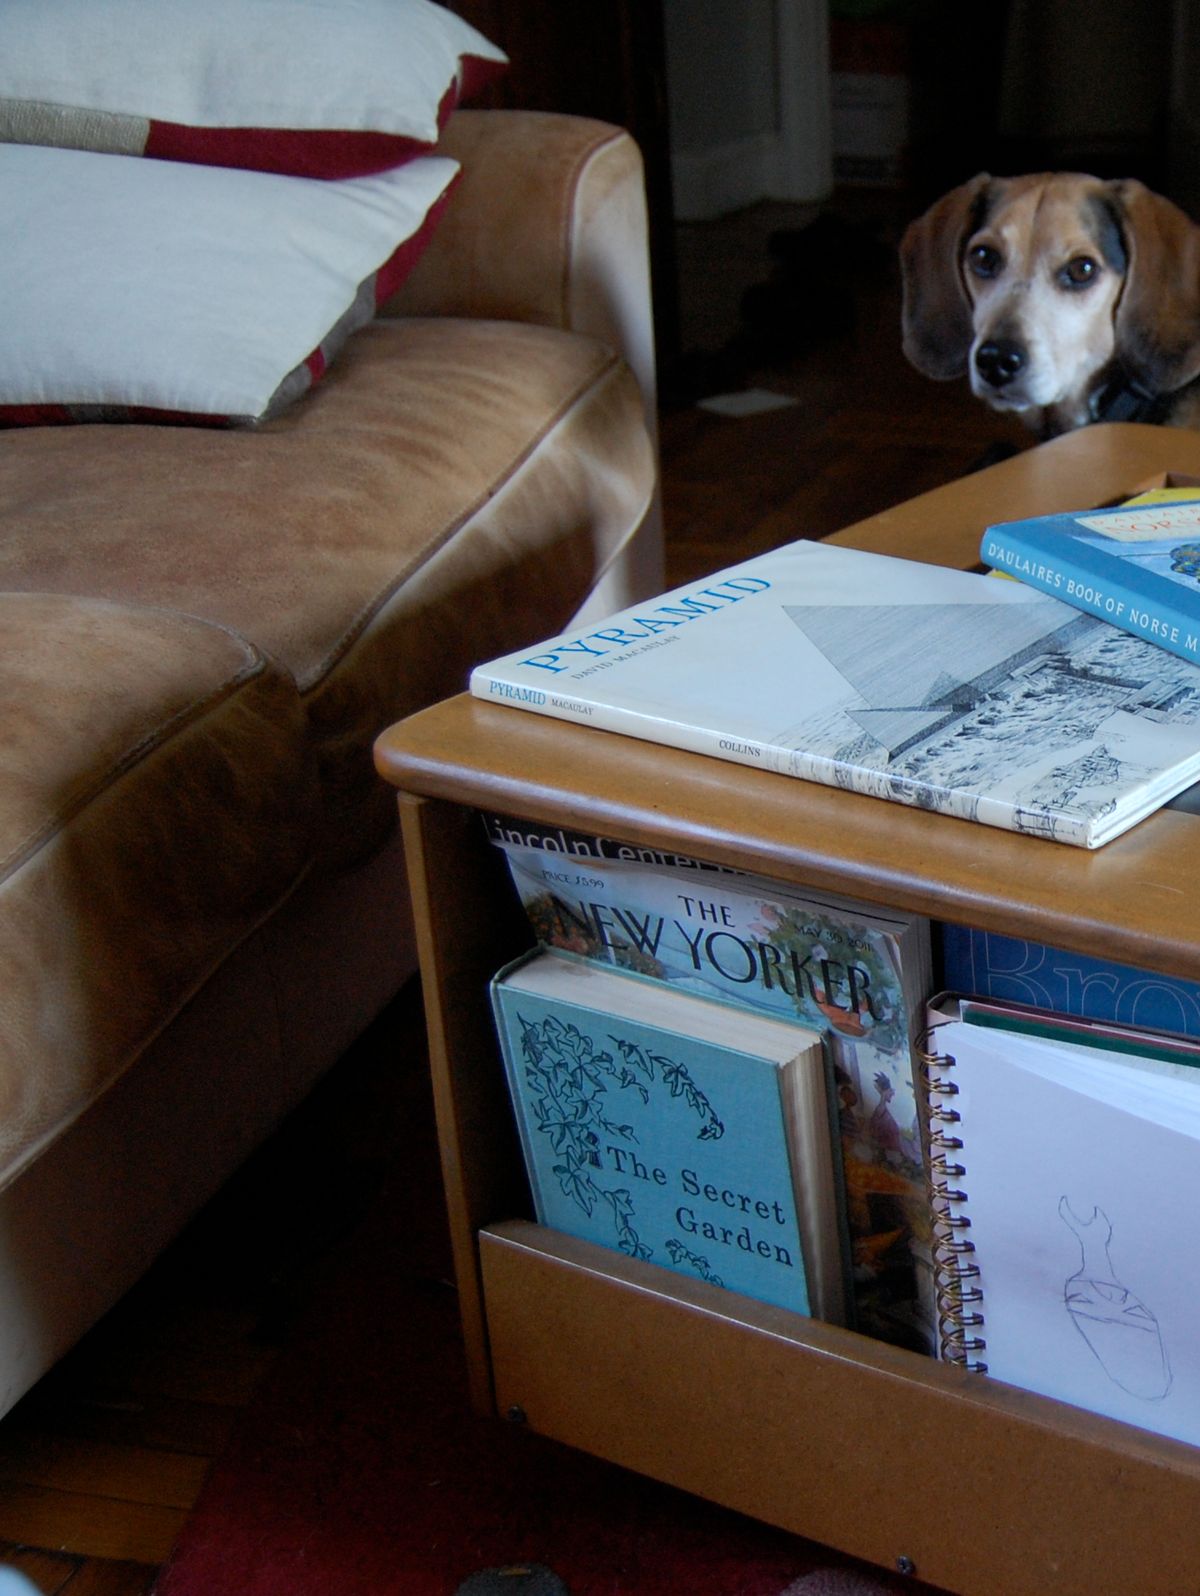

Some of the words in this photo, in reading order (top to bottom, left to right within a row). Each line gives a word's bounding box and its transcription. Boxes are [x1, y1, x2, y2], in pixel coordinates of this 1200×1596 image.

[517, 577, 772, 674] PYRAMID
[1066, 580, 1103, 607] BOOK
[1105, 598, 1124, 616] OF
[1130, 609, 1179, 643] NORSE
[571, 661, 614, 680] DAVID
[613, 635, 680, 663] MACAULAY
[489, 680, 546, 706] PYRAMID
[551, 698, 594, 716] MACAULAY
[718, 739, 761, 758] COLLINS
[541, 870, 569, 884] PRICE
[678, 895, 735, 928] THE
[550, 893, 664, 958] NEW
[673, 919, 886, 1022] YORKER
[848, 938, 872, 952] 2011
[607, 1147, 667, 1185] The
[681, 1168, 786, 1225] Secret
[676, 1207, 793, 1267] Garden
